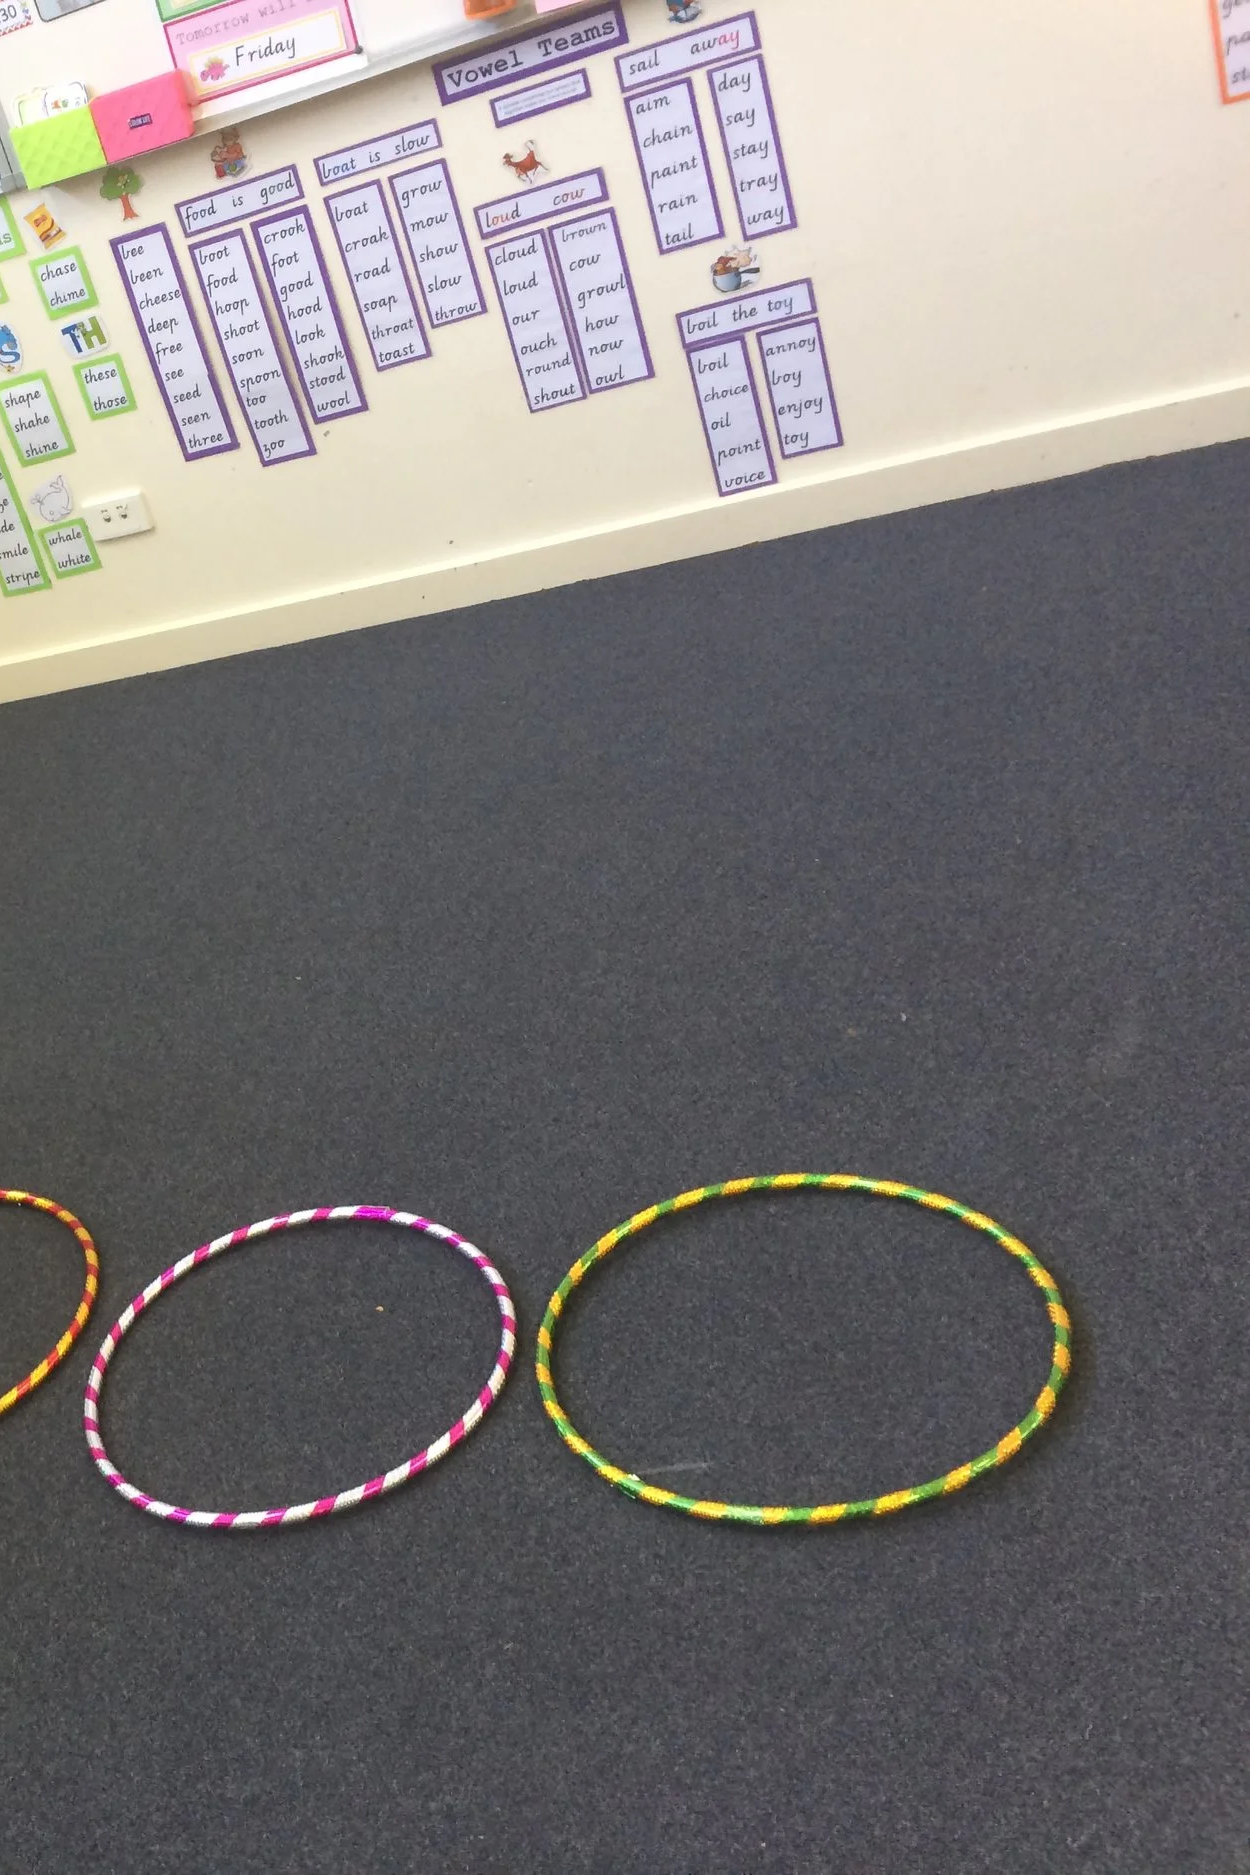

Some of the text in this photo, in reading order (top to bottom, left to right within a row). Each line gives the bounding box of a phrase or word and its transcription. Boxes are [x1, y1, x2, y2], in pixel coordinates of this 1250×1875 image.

[176, 13, 249, 45] Tomorrow
[235, 37, 295, 66] Friday
[447, 21, 615, 87] Vowel Teams
[630, 30, 739, 75] sail away
[718, 72, 750, 92] day
[643, 125, 693, 148] chain
[322, 135, 430, 179] boat is slow
[733, 140, 768, 160] stay
[651, 155, 698, 189] paint
[740, 173, 778, 192] tray
[185, 171, 295, 230] food is good
[402, 180, 442, 209] grow
[658, 194, 698, 213] rain
[486, 188, 585, 228] loud cow
[747, 206, 784, 225] way
[264, 218, 305, 244] crook
[345, 226, 389, 253] croak
[562, 222, 607, 242] brown
[665, 223, 694, 245] tail
[121, 245, 144, 260] bee
[199, 246, 230, 265] boot
[419, 243, 458, 263] show
[495, 238, 538, 266] cloud
[41, 262, 77, 282] chase
[271, 251, 299, 277] foot
[354, 257, 391, 283] road
[139, 289, 181, 310] cheese
[577, 273, 626, 309] growl
[215, 298, 249, 316] hoop
[287, 296, 322, 320] hood
[364, 295, 398, 313] soap
[435, 302, 478, 321] throw
[148, 318, 178, 334] deep
[585, 315, 619, 333] how
[687, 297, 793, 334] boil the toy
[61, 316, 107, 352] TH
[224, 320, 260, 341] shoot
[295, 324, 326, 345] look
[371, 318, 414, 340] throat
[155, 342, 183, 365] free
[379, 343, 415, 363] toast
[520, 332, 557, 355] ouch
[765, 337, 816, 357] annoy
[304, 345, 345, 369] shook
[526, 352, 572, 376] round
[84, 369, 117, 384] these
[240, 369, 281, 393] spoon
[309, 366, 346, 389] stood
[595, 364, 625, 386] owl
[5, 390, 41, 408] shape
[173, 383, 202, 404] seed
[317, 390, 350, 412] wool
[534, 383, 576, 405] shout
[704, 384, 749, 403] choice
[94, 396, 128, 413] those
[778, 397, 823, 419] enjoy
[14, 412, 50, 433] shake
[254, 409, 288, 430] tooth
[25, 442, 59, 458] shine
[188, 433, 224, 449] three
[718, 439, 761, 467] point
[725, 471, 765, 488] voice
[48, 528, 82, 546] whale
[58, 554, 91, 573] white
[6, 571, 40, 586] stripe
